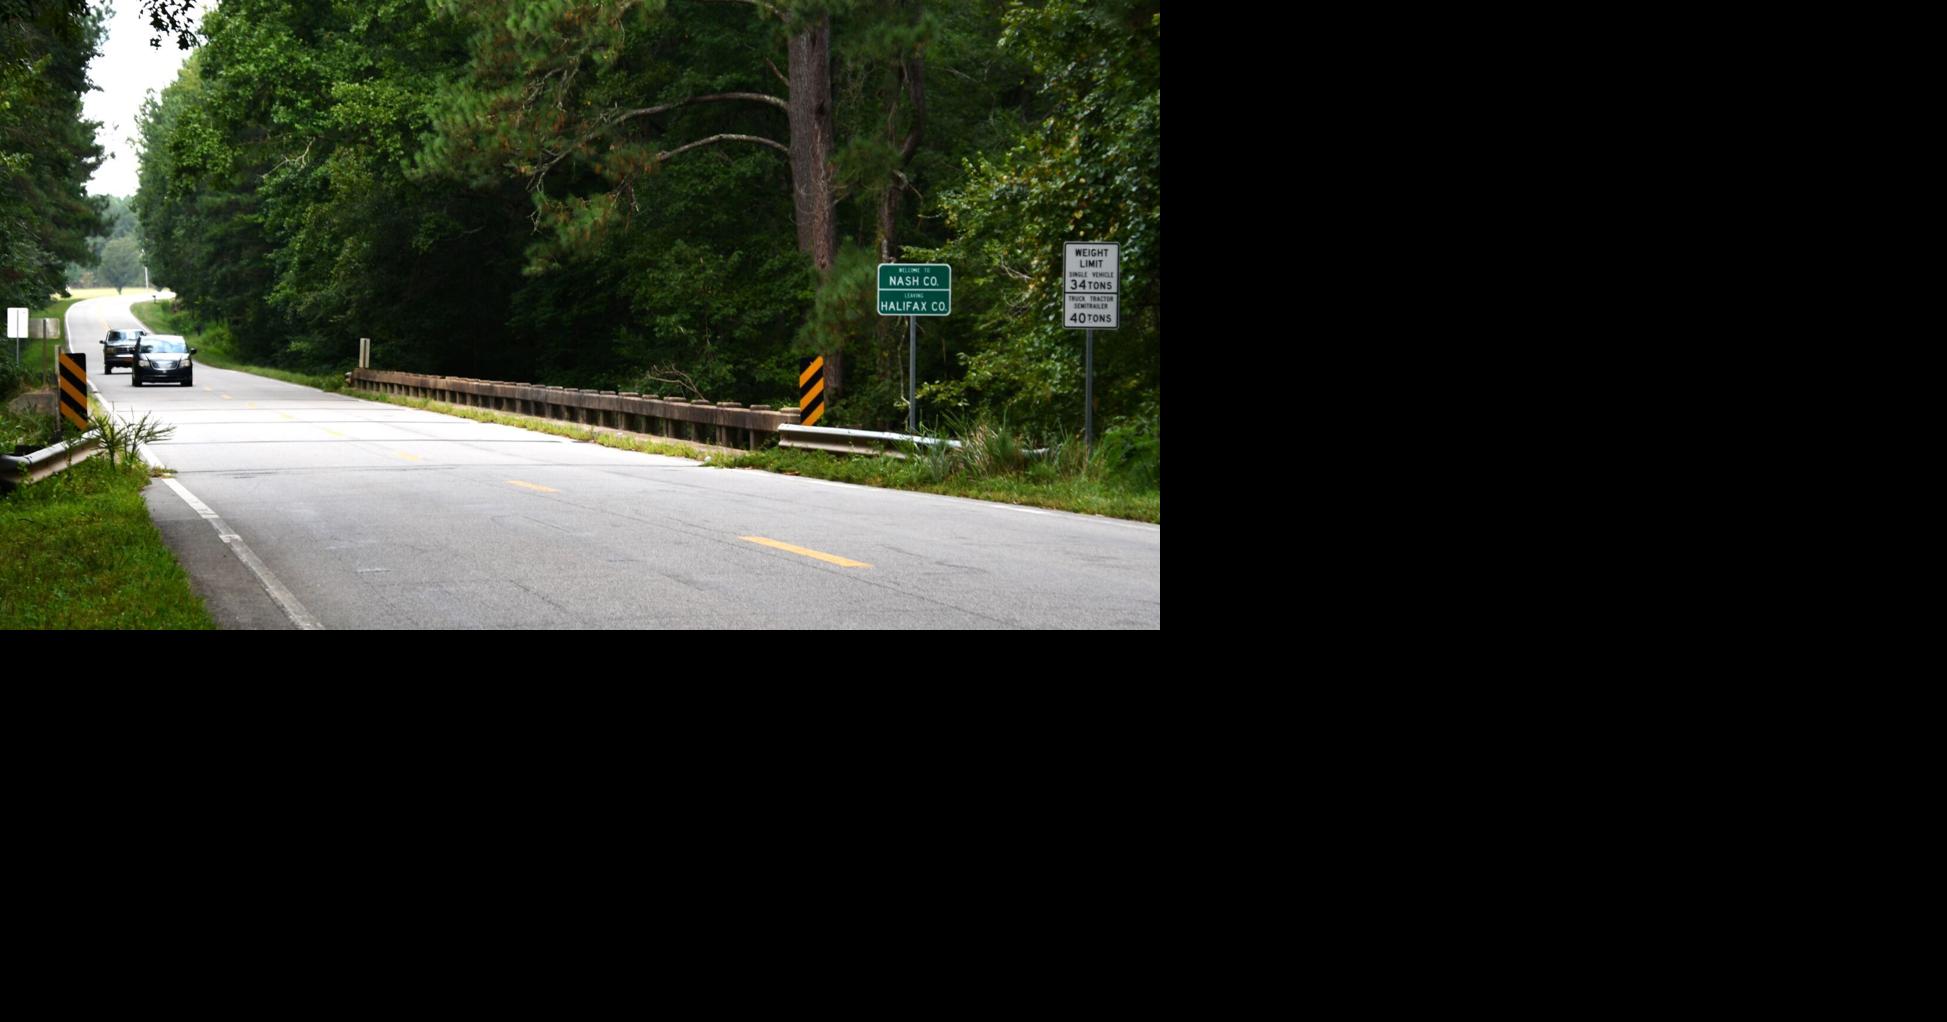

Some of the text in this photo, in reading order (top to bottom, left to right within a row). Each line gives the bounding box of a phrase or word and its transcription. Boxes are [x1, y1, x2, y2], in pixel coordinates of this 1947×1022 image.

[1075, 248, 1108, 257] WEIGHT
[1080, 260, 1103, 268] LIMIT
[889, 276, 939, 286] NASH CO.
[1070, 280, 1112, 290] 34 TONS
[881, 301, 947, 311] HALIFAX CO.
[1070, 313, 1112, 323] 40 TONS
